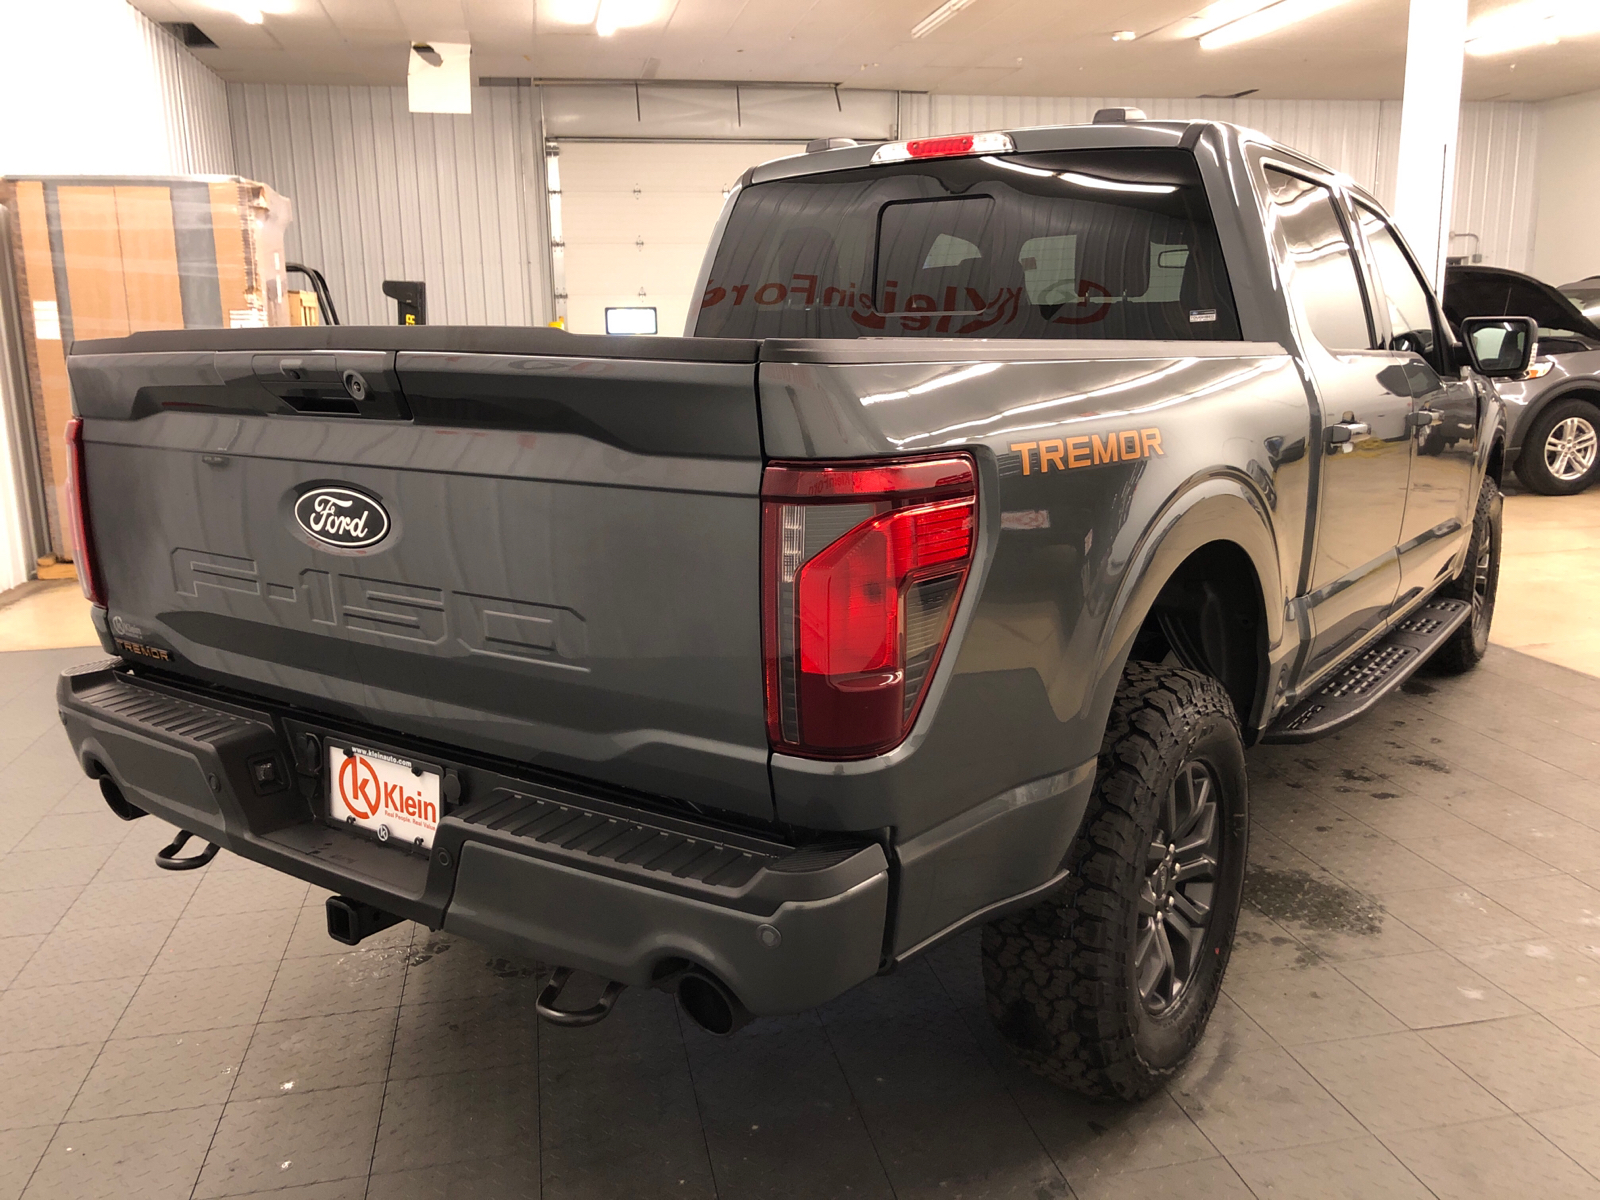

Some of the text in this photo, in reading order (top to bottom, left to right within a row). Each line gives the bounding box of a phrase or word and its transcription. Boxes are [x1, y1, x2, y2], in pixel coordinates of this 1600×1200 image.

[1010, 427, 1164, 476] TREMOR
[309, 495, 369, 538] Ford
[172, 546, 591, 672] F-150
[114, 637, 169, 662] TREMOR
[351, 746, 412, 769] www.kleinauto.com
[384, 781, 437, 823] Klein
[384, 810, 395, 818] Real
[412, 818, 423, 827] Real
